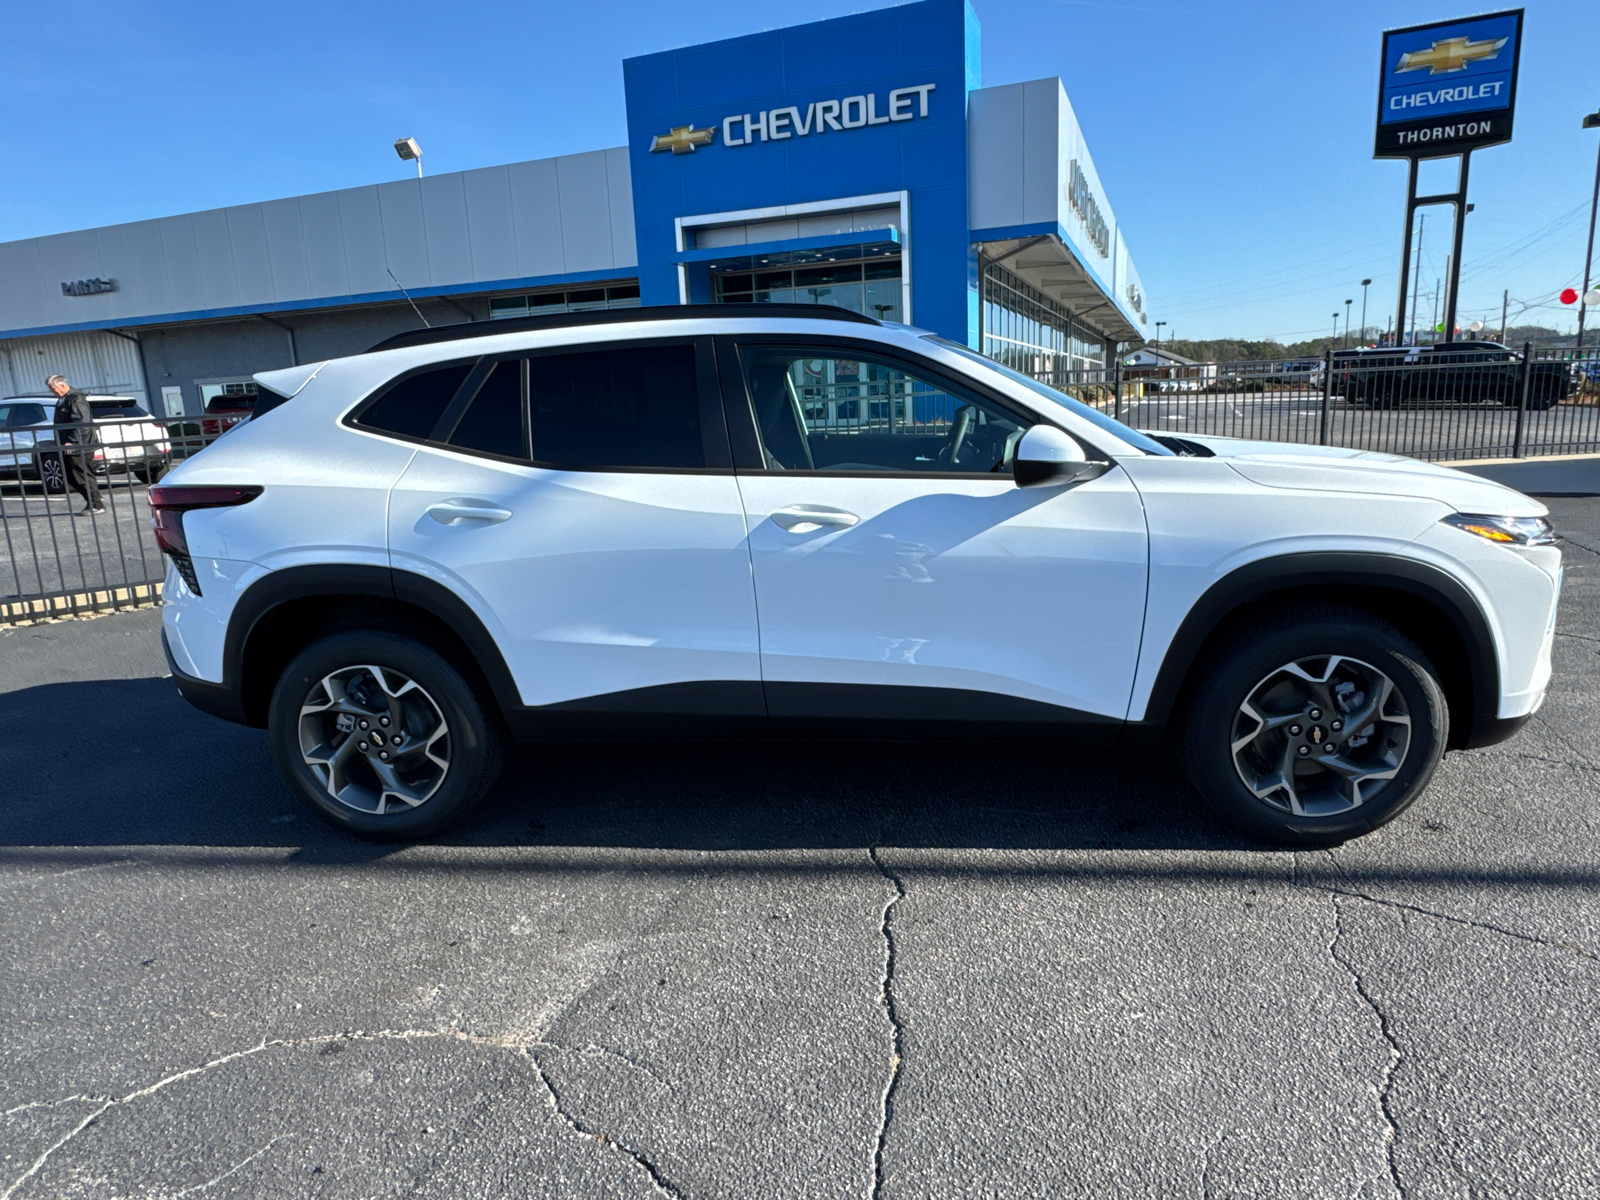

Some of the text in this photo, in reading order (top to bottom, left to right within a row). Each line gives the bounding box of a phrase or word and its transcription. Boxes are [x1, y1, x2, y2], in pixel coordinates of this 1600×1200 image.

[1390, 81, 1504, 110] CHEVROLET
[722, 83, 936, 147] CHEVROLET
[1397, 120, 1491, 144] THORNTON
